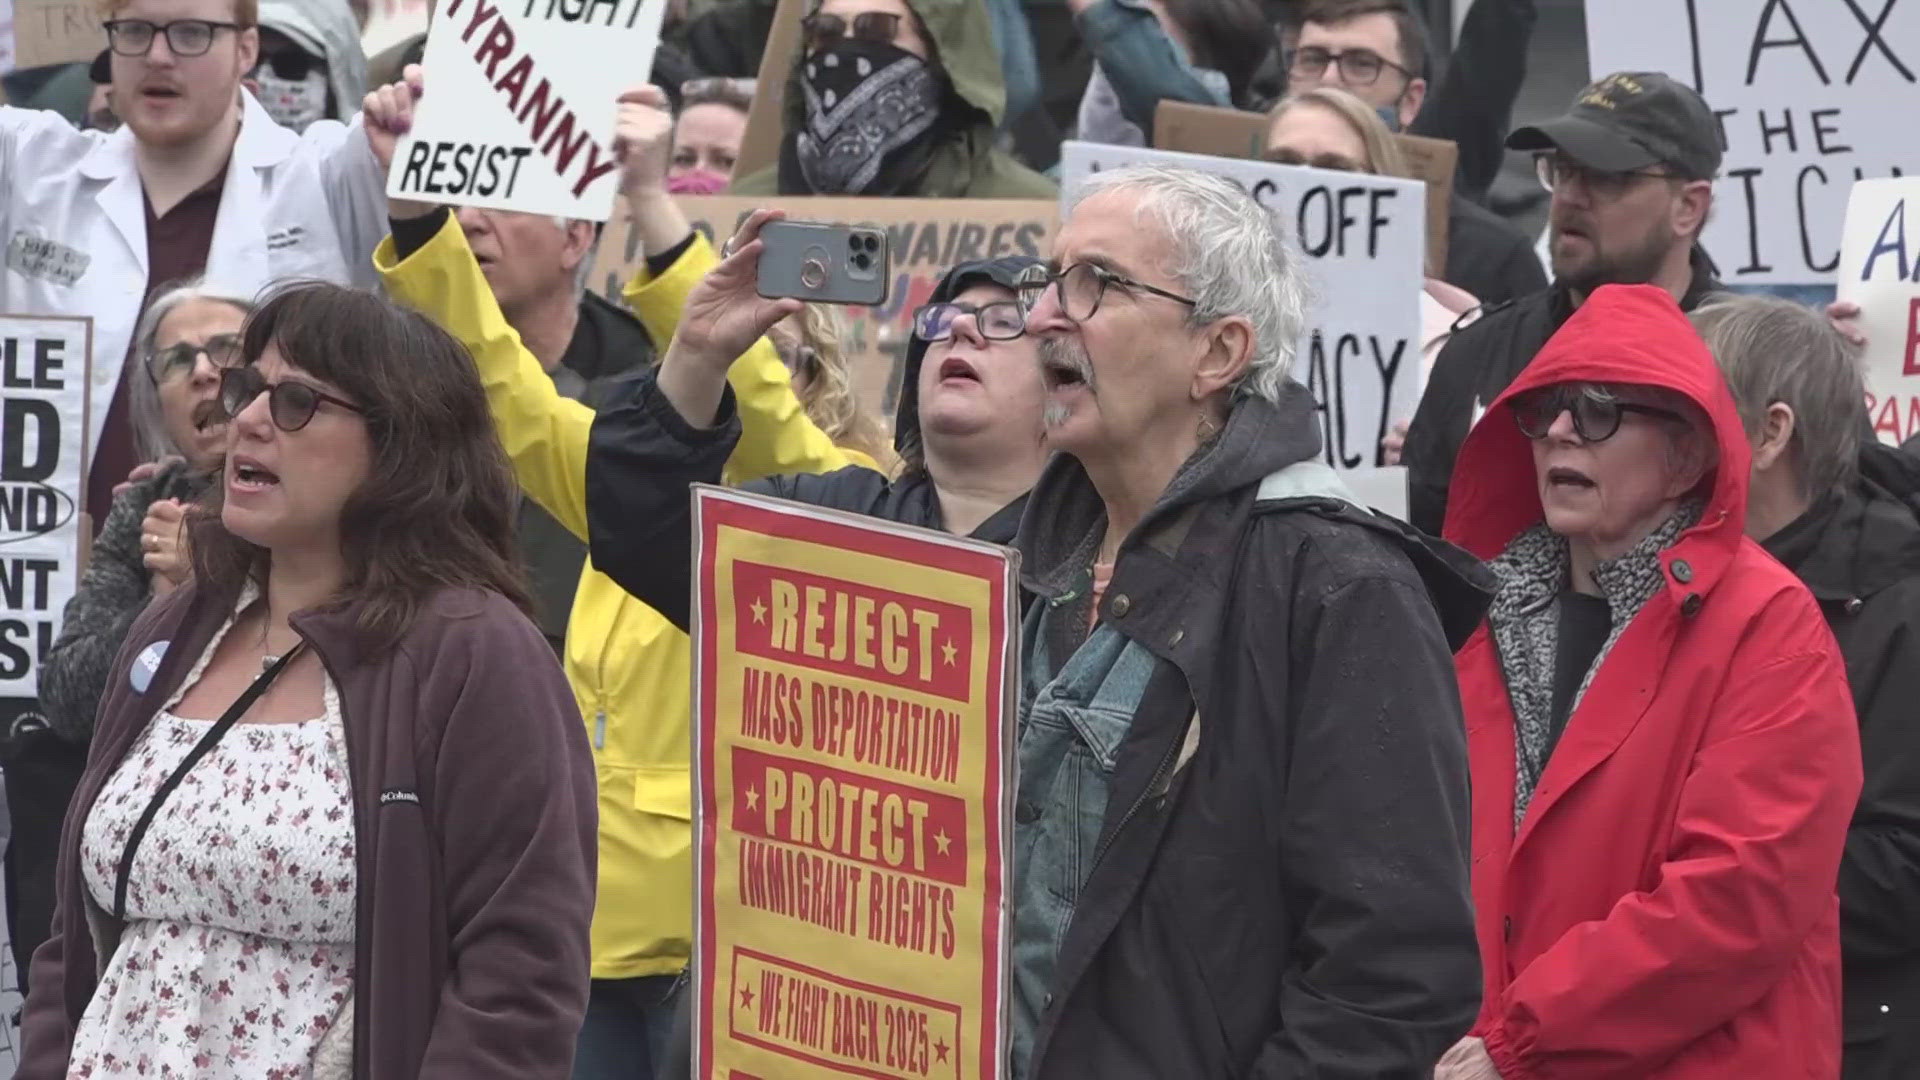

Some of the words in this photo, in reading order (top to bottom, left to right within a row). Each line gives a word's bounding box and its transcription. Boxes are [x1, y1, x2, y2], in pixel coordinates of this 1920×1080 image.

[400, 140, 533, 199] RESIST
[1711, 109, 1854, 155] THE
[1298, 184, 1398, 259] OFF
[0, 337, 65, 390] LE
[770, 577, 940, 683] REJECT
[740, 666, 803, 749] MASS
[810, 680, 961, 786] DEPORTATION
[764, 765, 929, 872] PROTECT
[739, 837, 862, 937] IMMIGRANT
[868, 870, 955, 960] RIGHTS
[758, 968, 784, 1037] WE
[785, 976, 829, 1051] FIGHT
[831, 990, 880, 1064] BACK
[885, 1003, 930, 1077] 2025
